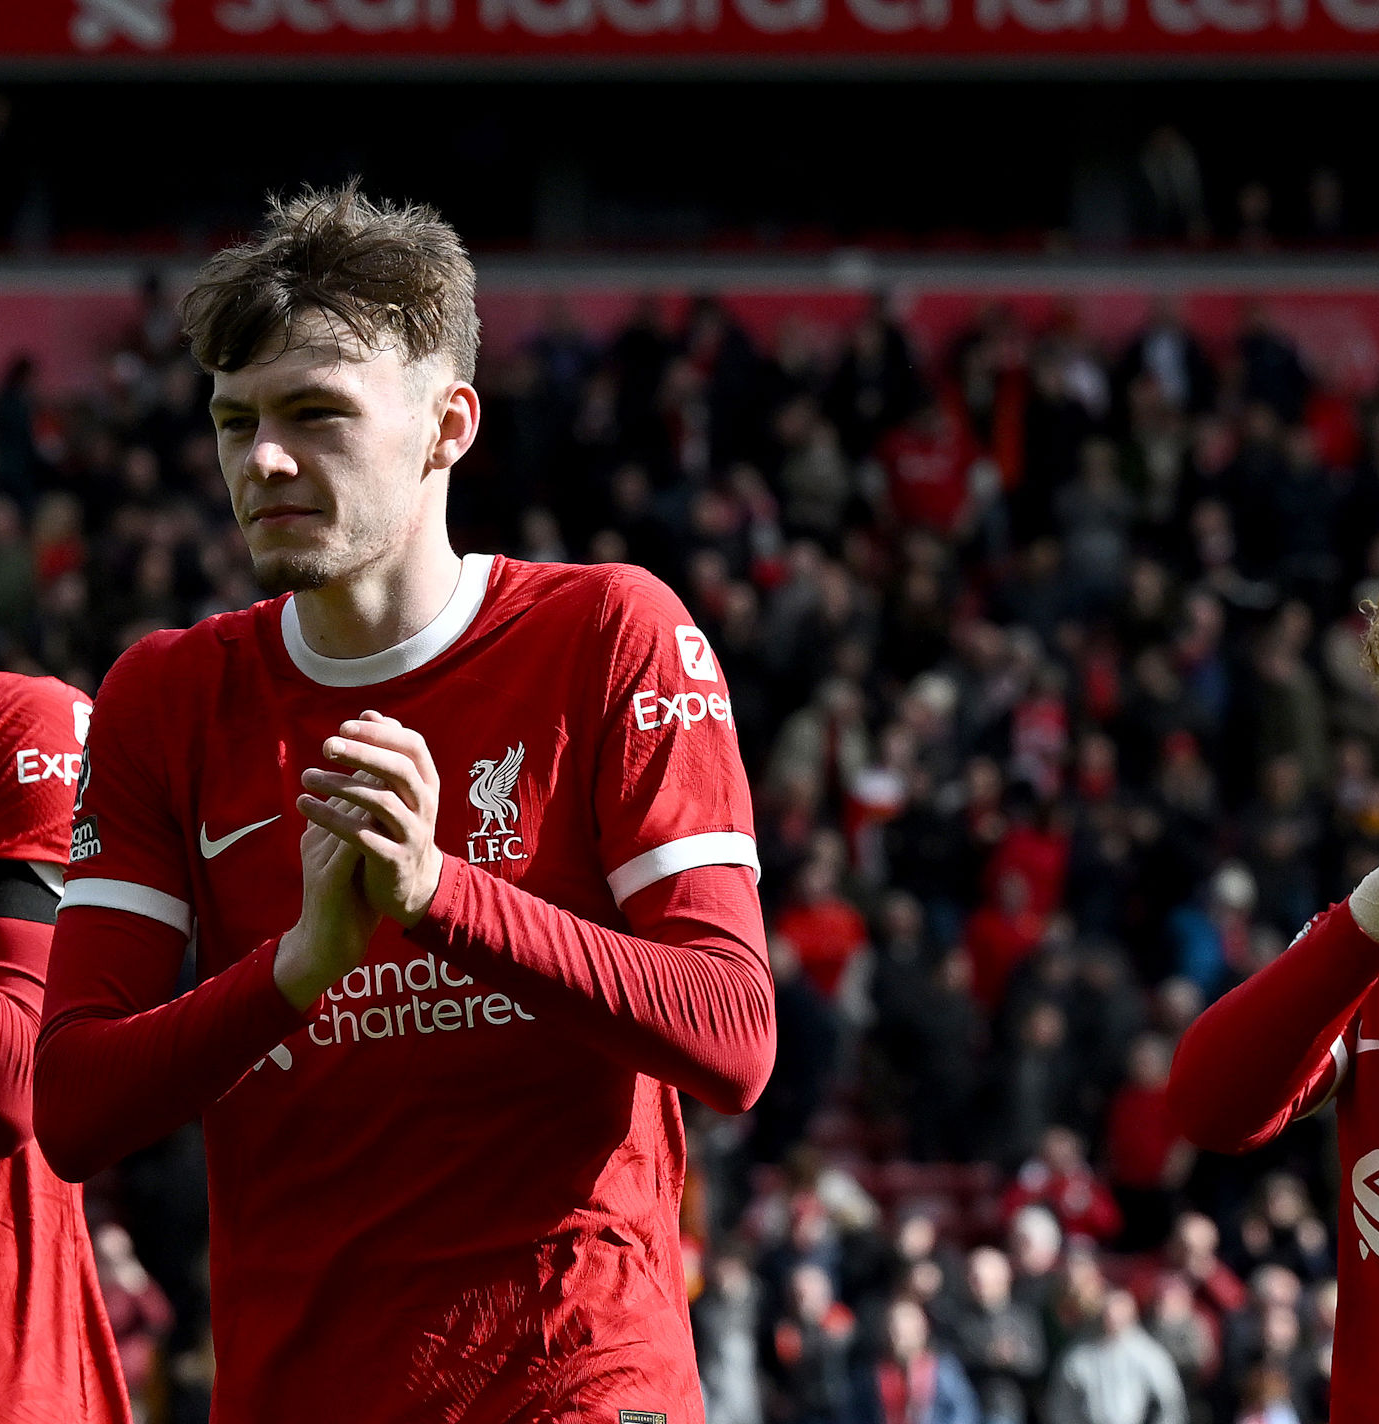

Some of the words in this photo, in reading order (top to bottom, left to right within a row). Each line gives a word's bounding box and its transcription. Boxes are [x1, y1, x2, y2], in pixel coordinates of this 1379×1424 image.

[633, 690, 734, 731] Expe
[467, 836, 528, 864] L.F.C.
[308, 993, 535, 1046] chartere
